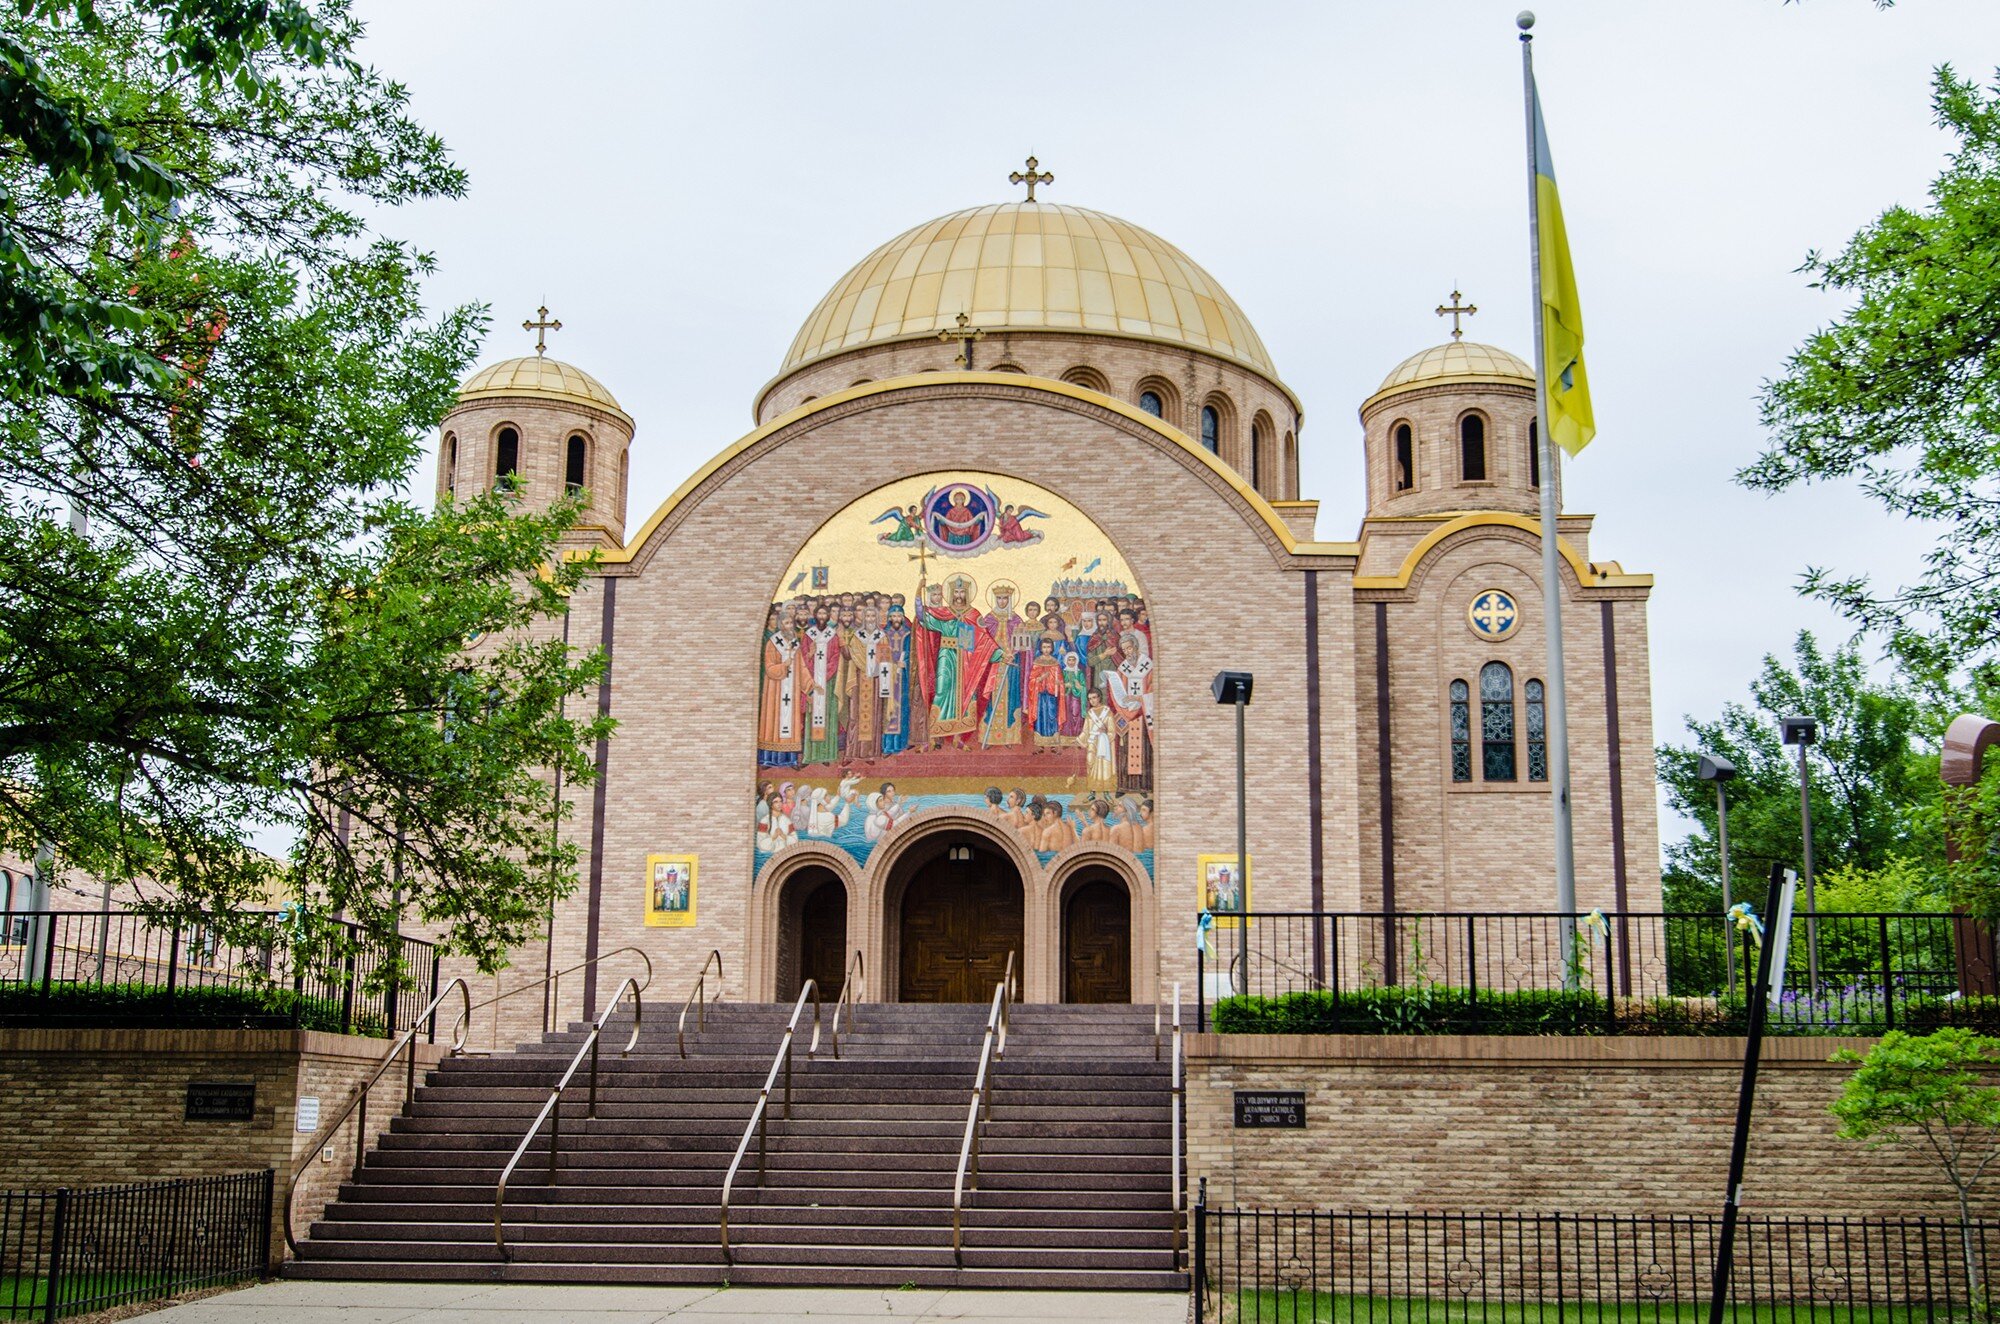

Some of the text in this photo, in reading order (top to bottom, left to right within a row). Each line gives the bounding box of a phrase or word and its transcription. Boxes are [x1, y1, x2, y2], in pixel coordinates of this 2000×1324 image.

[1279, 1096, 1289, 1104] AND
[1271, 1106, 1295, 1114] CATHOLIC
[1260, 1115, 1280, 1123] CHURCH
